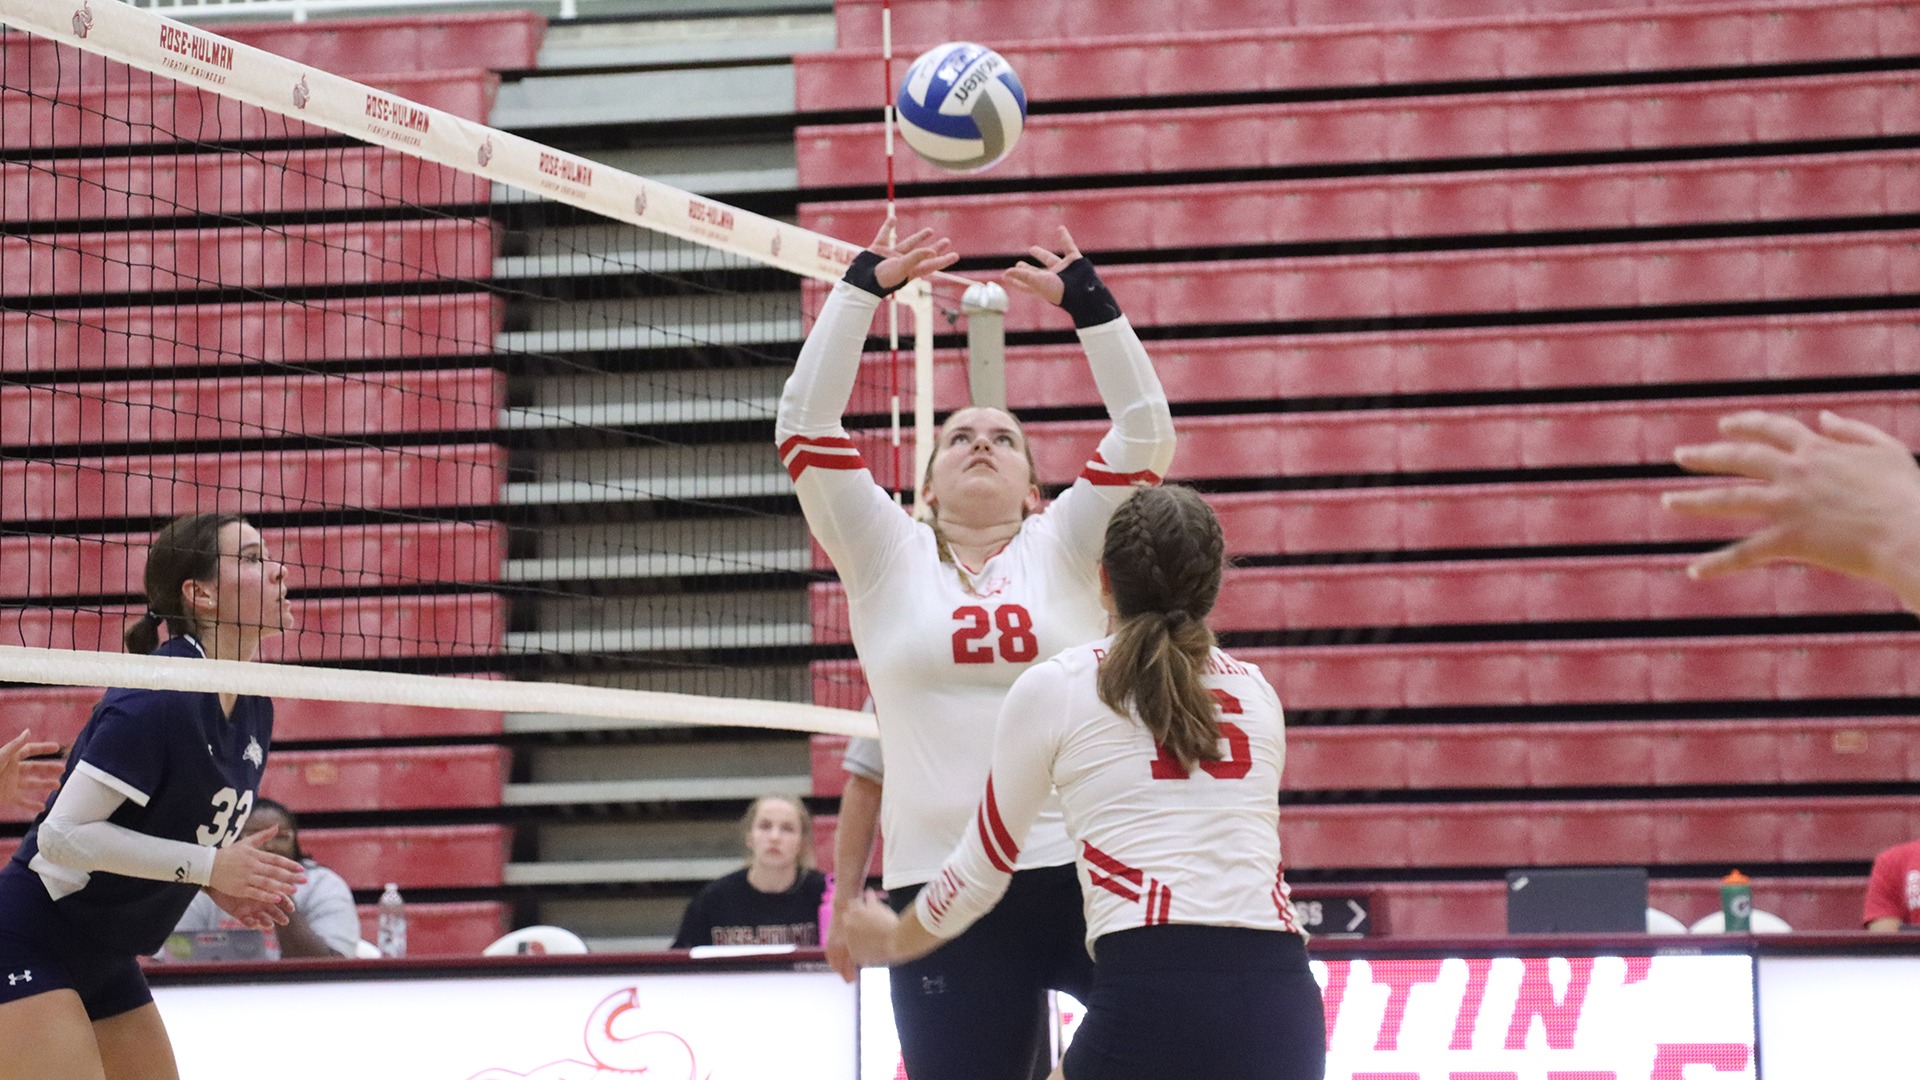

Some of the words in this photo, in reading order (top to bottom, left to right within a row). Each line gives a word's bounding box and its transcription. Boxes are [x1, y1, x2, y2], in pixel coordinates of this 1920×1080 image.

[160, 24, 234, 71] ROSE-HULMAN
[365, 94, 429, 134] ROSE-HULMAN
[539, 152, 592, 187] ROSE-HULMAN
[952, 604, 1038, 664] 28
[196, 786, 253, 848] 33
